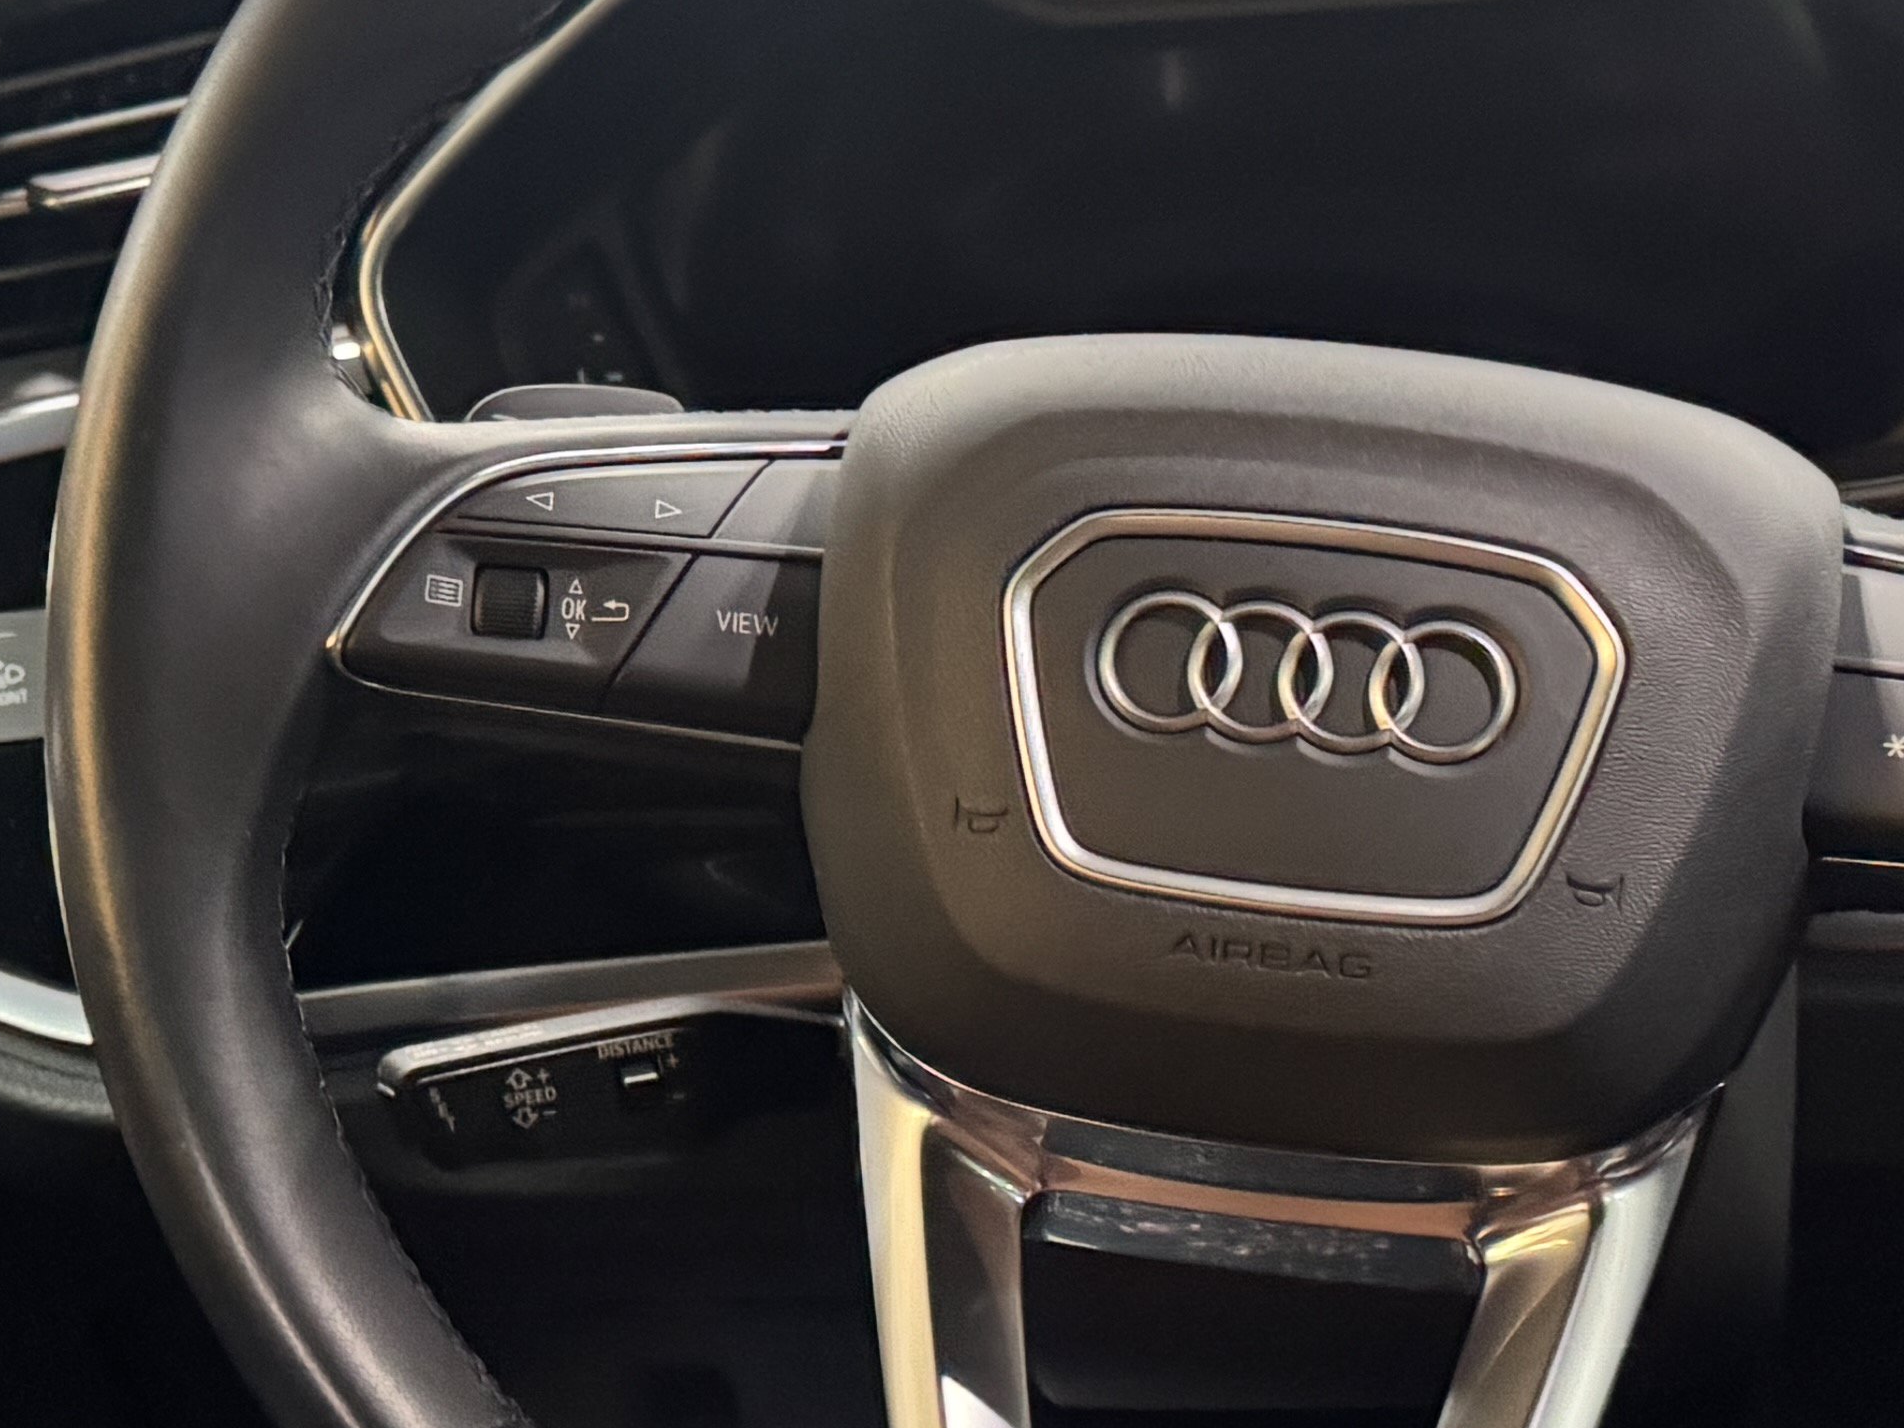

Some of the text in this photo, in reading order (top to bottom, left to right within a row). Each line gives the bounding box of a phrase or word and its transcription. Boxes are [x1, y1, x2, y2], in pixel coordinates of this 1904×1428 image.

[561, 597, 586, 622] OK
[716, 609, 779, 638] VIEW
[1170, 932, 1375, 982] AIRBAG
[596, 1033, 675, 1060] DISTANCE
[503, 1086, 558, 1109] SPEED
